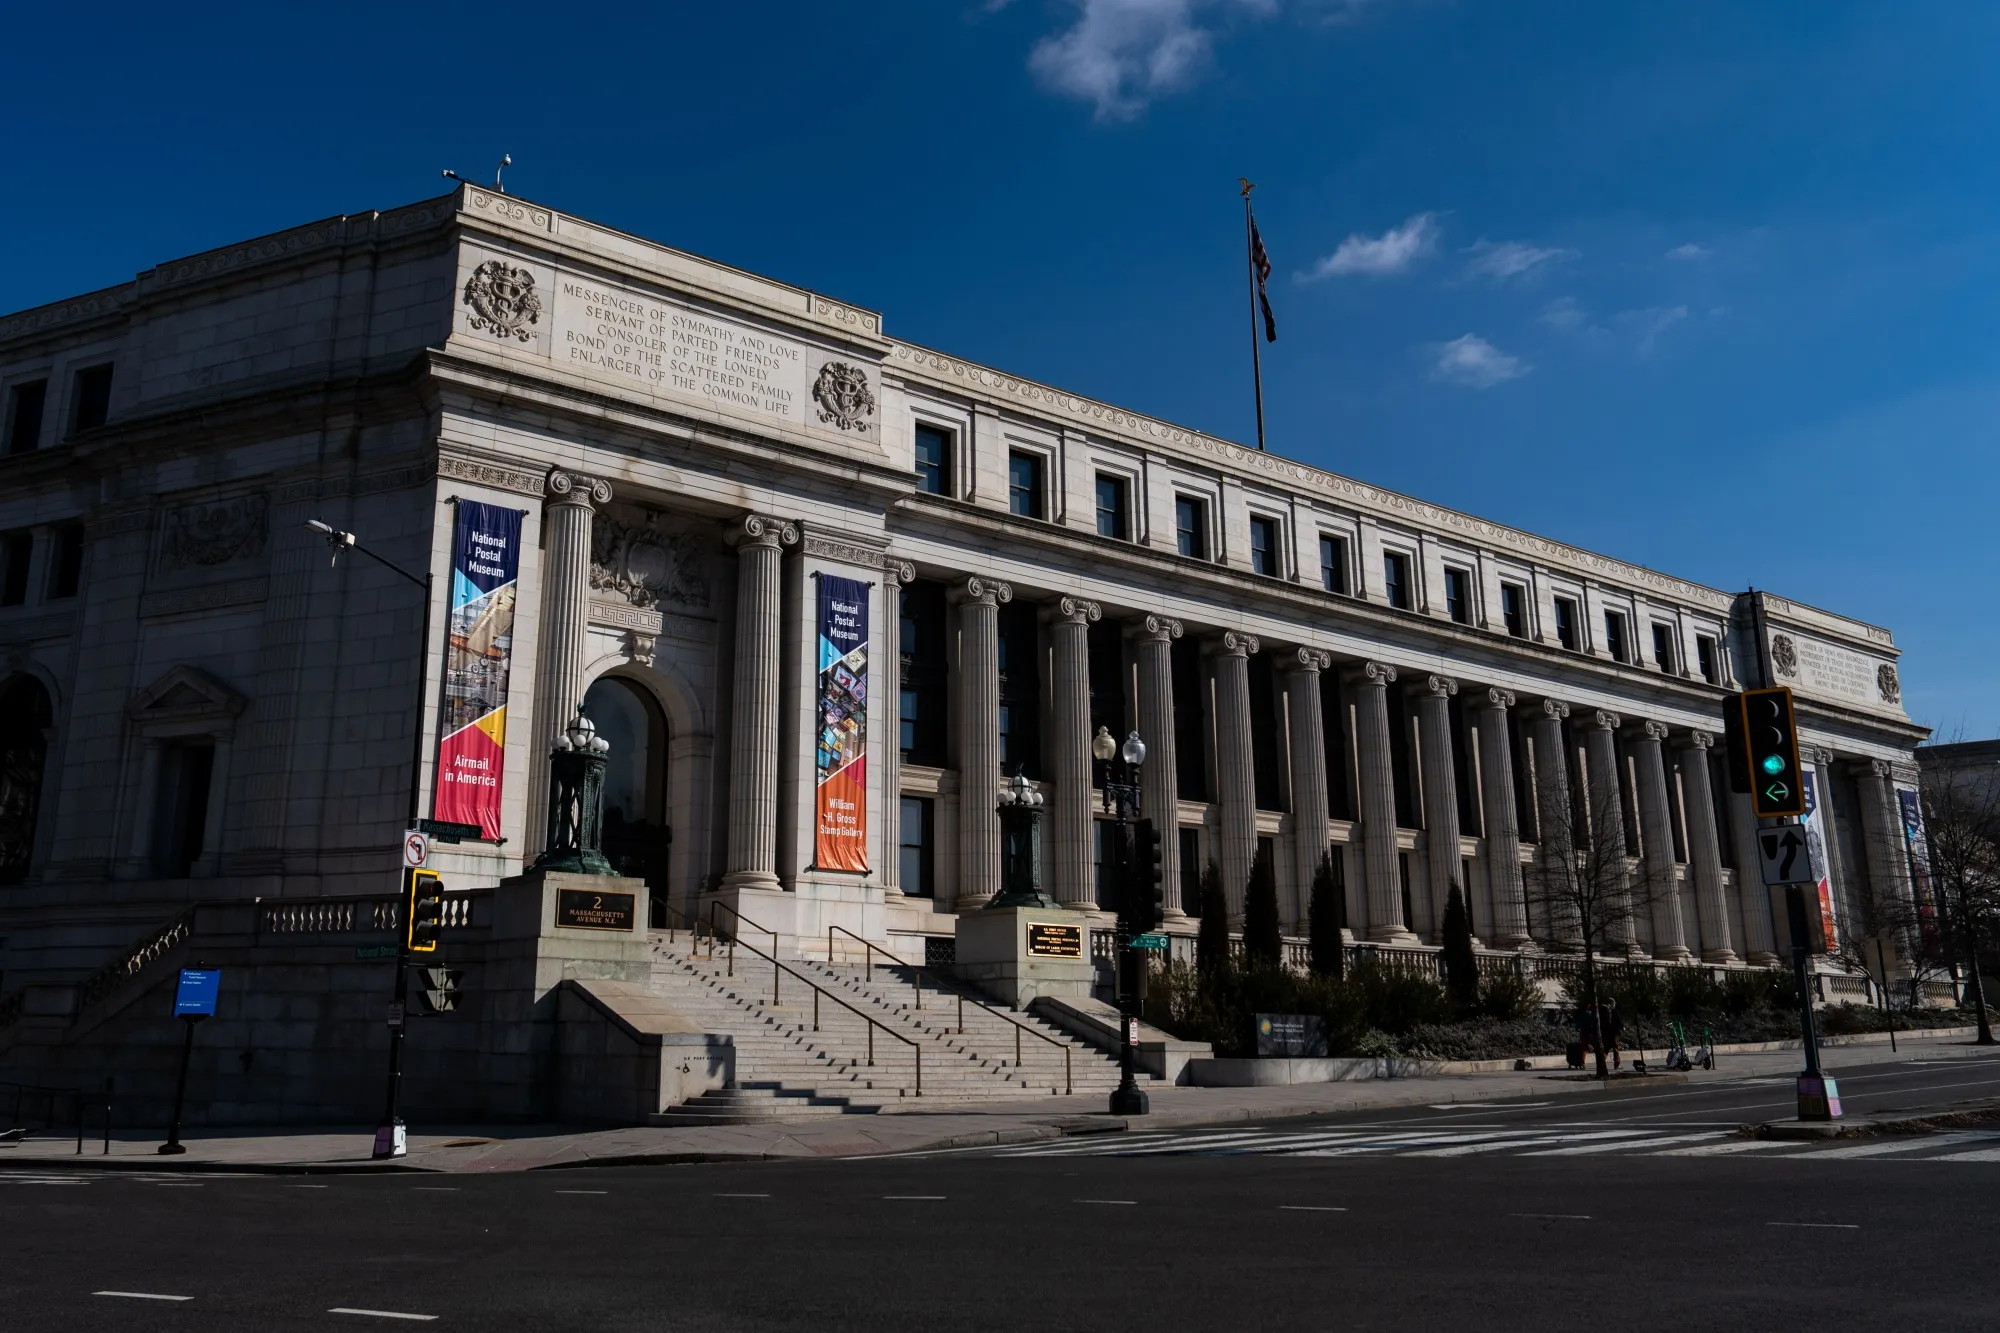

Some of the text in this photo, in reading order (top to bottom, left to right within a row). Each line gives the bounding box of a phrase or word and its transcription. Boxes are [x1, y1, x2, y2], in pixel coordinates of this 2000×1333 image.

[563, 283, 798, 360] MESSENGER OF SYMPATHY AND LOVE
[585, 306, 780, 370] SERVANT OF PARTED FRIENDS
[597, 324, 770, 380] CONSOLER OF THE LONELY
[566, 330, 794, 402] BOND OF THE SCATTERED FAMILY
[570, 348, 789, 416] ENLARGER OF THE COMMON LIFE
[472, 530, 506, 548] National
[475, 546, 501, 562] Postal
[468, 560, 504, 578] Museum
[832, 600, 858, 615] National
[834, 614, 855, 627] Postal
[830, 626, 858, 641] Museum
[454, 754, 488, 770] Airmail
[445, 769, 496, 786] in America
[829, 798, 855, 810] William
[828, 812, 856, 824] H. Gross
[820, 824, 863, 839] Stamp Gallery
[593, 896, 602, 909] 2
[569, 909, 624, 918] MASSACHUSETTS
